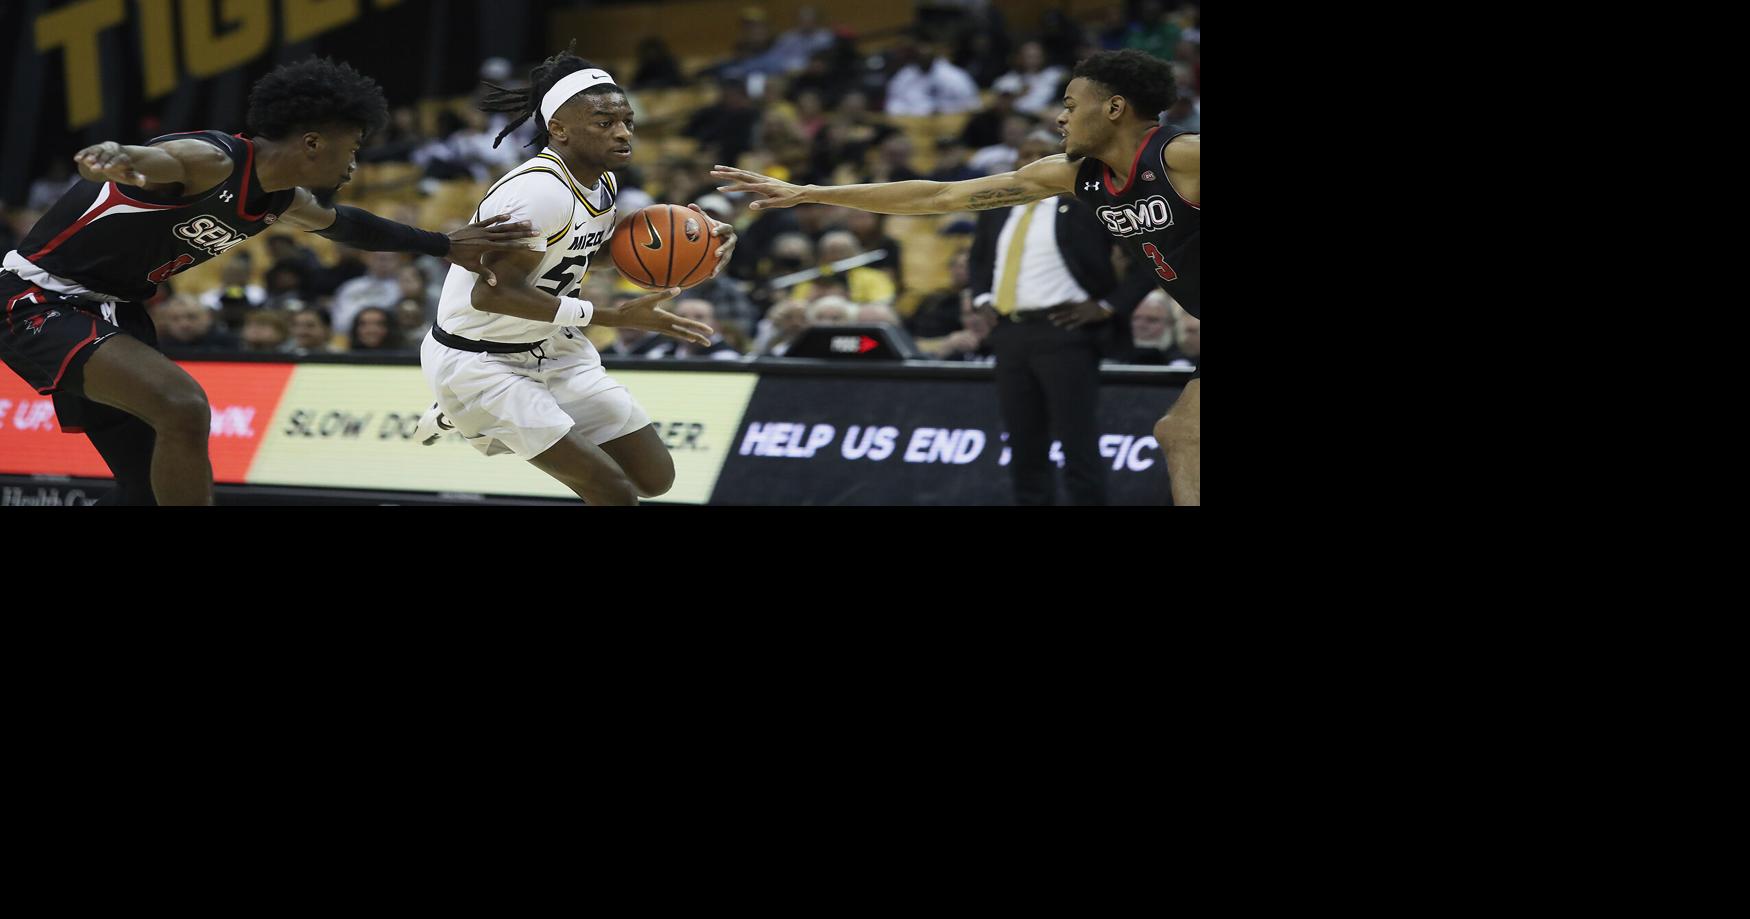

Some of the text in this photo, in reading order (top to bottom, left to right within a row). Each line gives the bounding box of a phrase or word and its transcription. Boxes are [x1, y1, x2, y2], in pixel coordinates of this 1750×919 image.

[176, 215, 246, 255] SEM
[1099, 198, 1172, 236] SEMO
[1142, 242, 1177, 281] 3
[284, 408, 374, 440] SLOW
[739, 422, 836, 458] HELP
[840, 425, 900, 461] US
[904, 428, 986, 465] END
